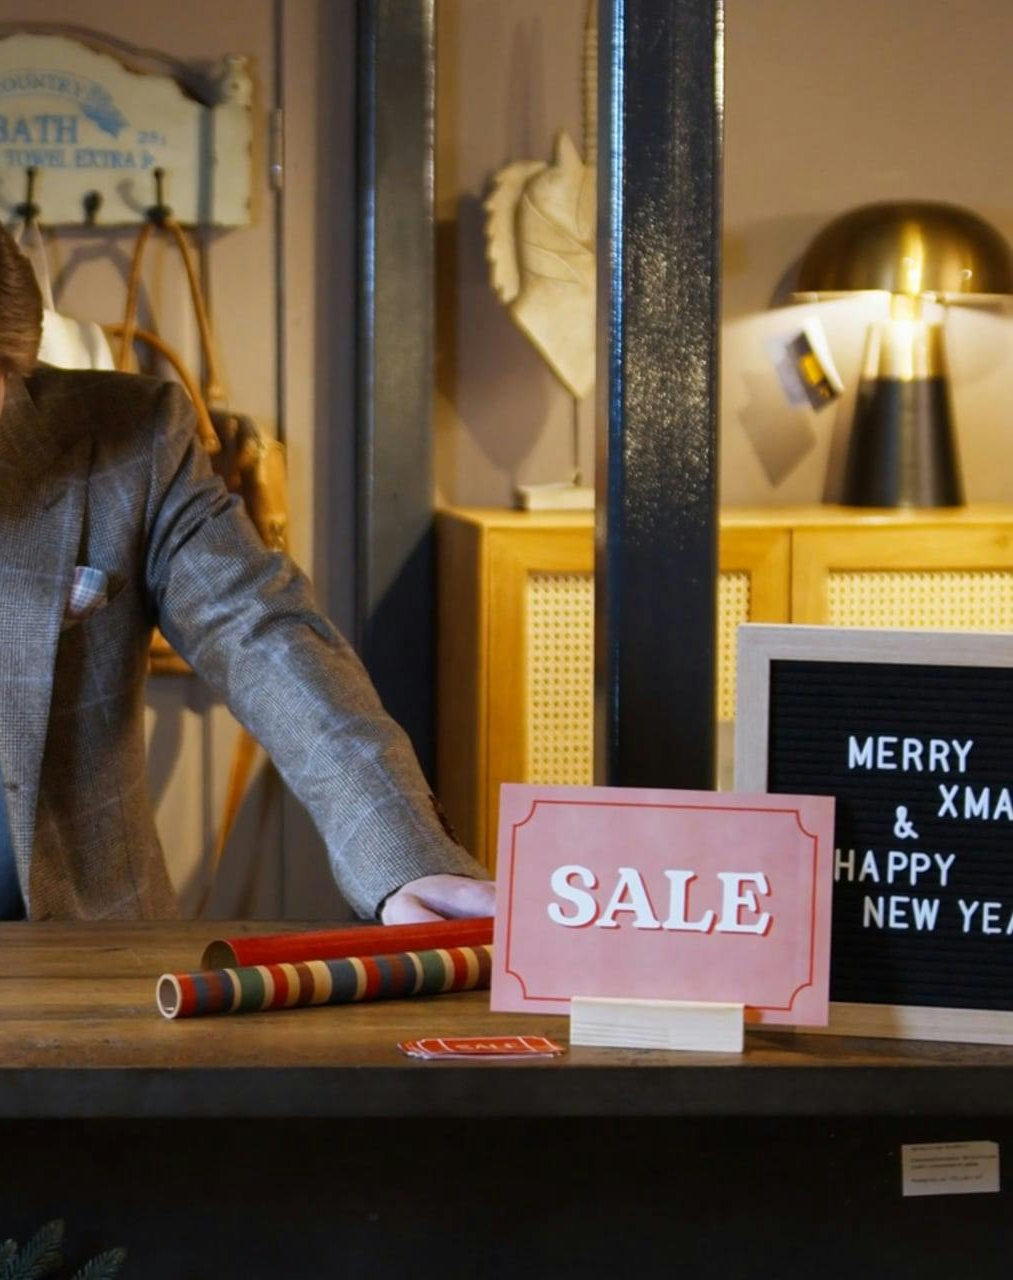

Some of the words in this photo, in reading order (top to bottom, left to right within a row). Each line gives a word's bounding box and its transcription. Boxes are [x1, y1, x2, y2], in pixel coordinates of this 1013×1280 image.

[4, 147, 66, 167] TOWEL
[74, 148, 136, 169] EXTRA
[848, 735, 974, 773] MERRY
[937, 783, 1013, 821] XMA
[893, 805, 918, 839] &
[835, 849, 956, 887] HAPPY
[546, 864, 774, 936] SALE
[863, 896, 940, 931] NEW
